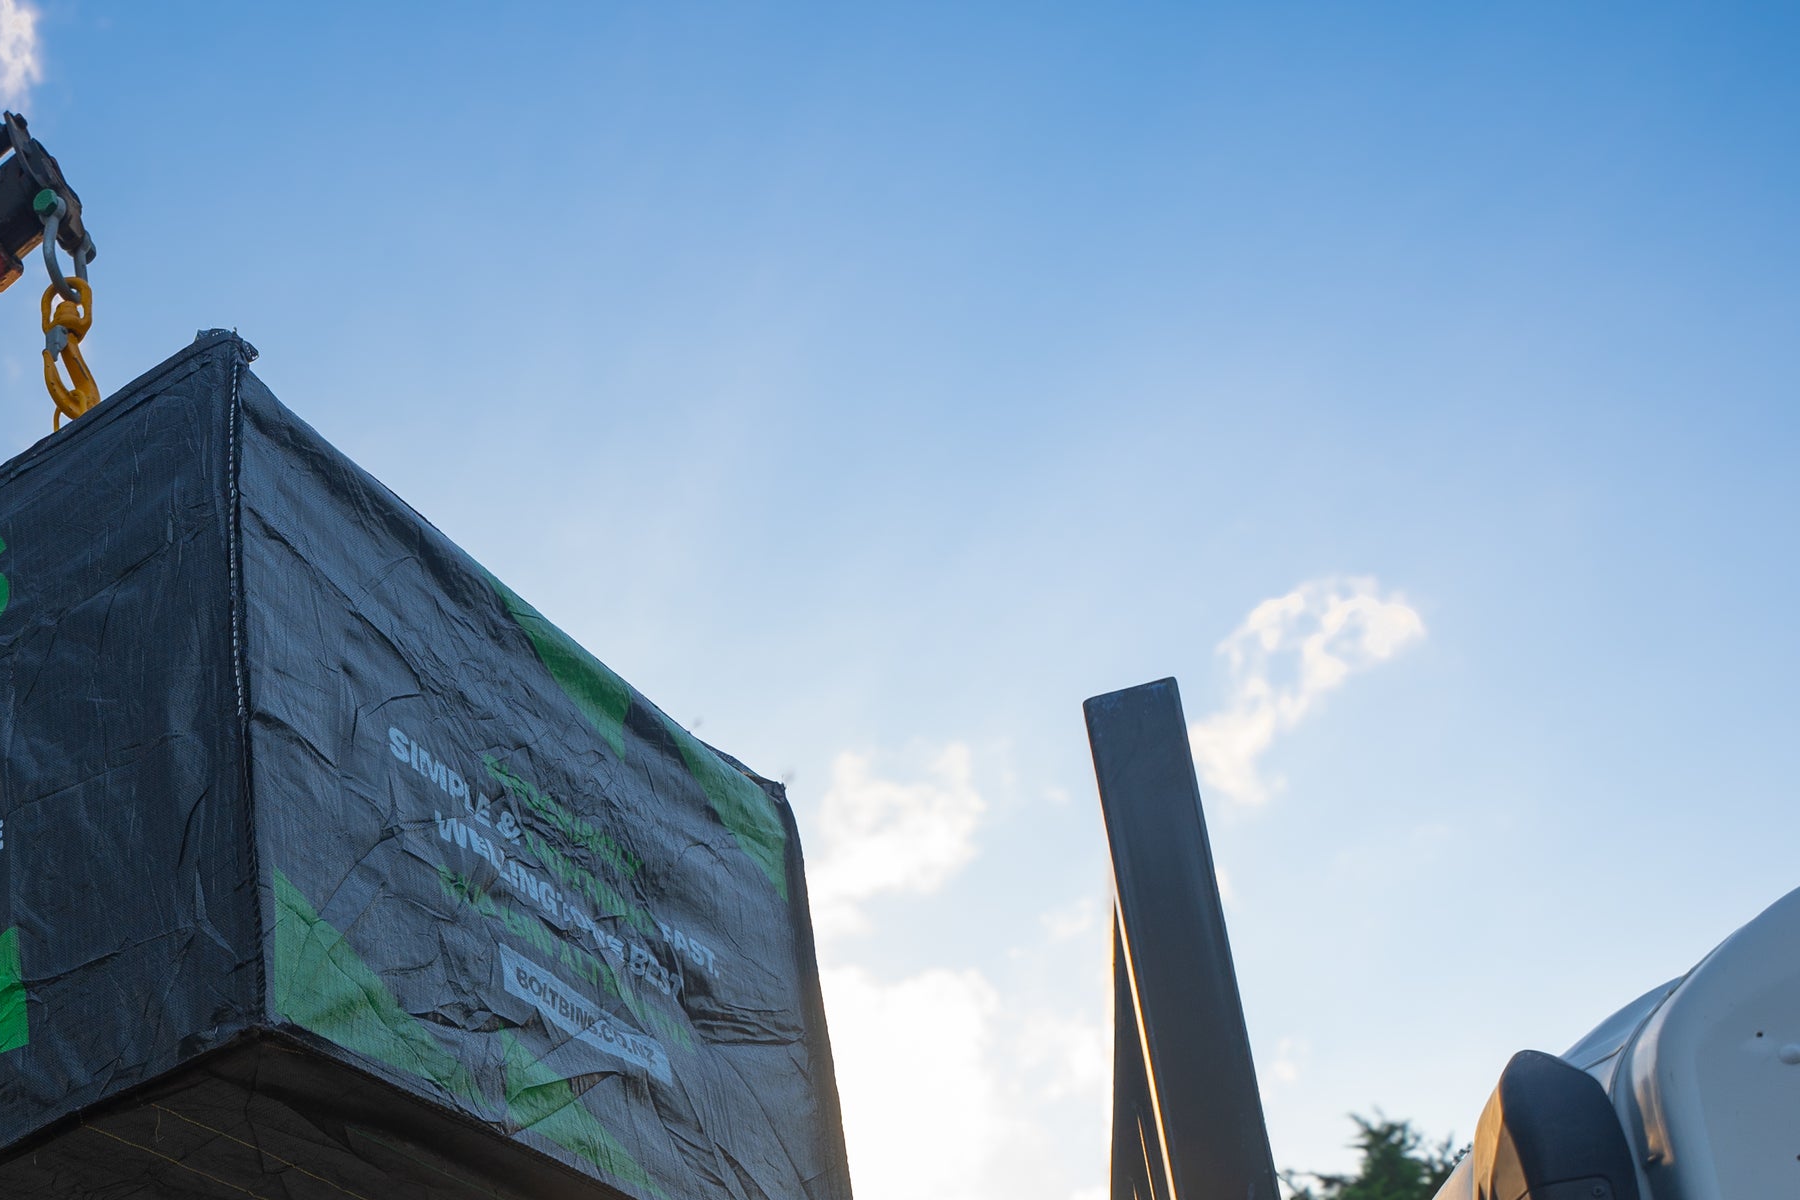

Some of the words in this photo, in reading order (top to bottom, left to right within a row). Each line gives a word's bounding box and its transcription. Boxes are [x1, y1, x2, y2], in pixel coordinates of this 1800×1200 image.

[388, 726, 492, 828] SIMPLE
[497, 810, 521, 846] &
[522, 829, 654, 937] LIGHTNING
[481, 754, 644, 880] SHOCKINGLY
[501, 905, 554, 958] BIN
[629, 943, 681, 1000] BEST
[516, 966, 658, 1070] BOLTBINS.CO.NZ
